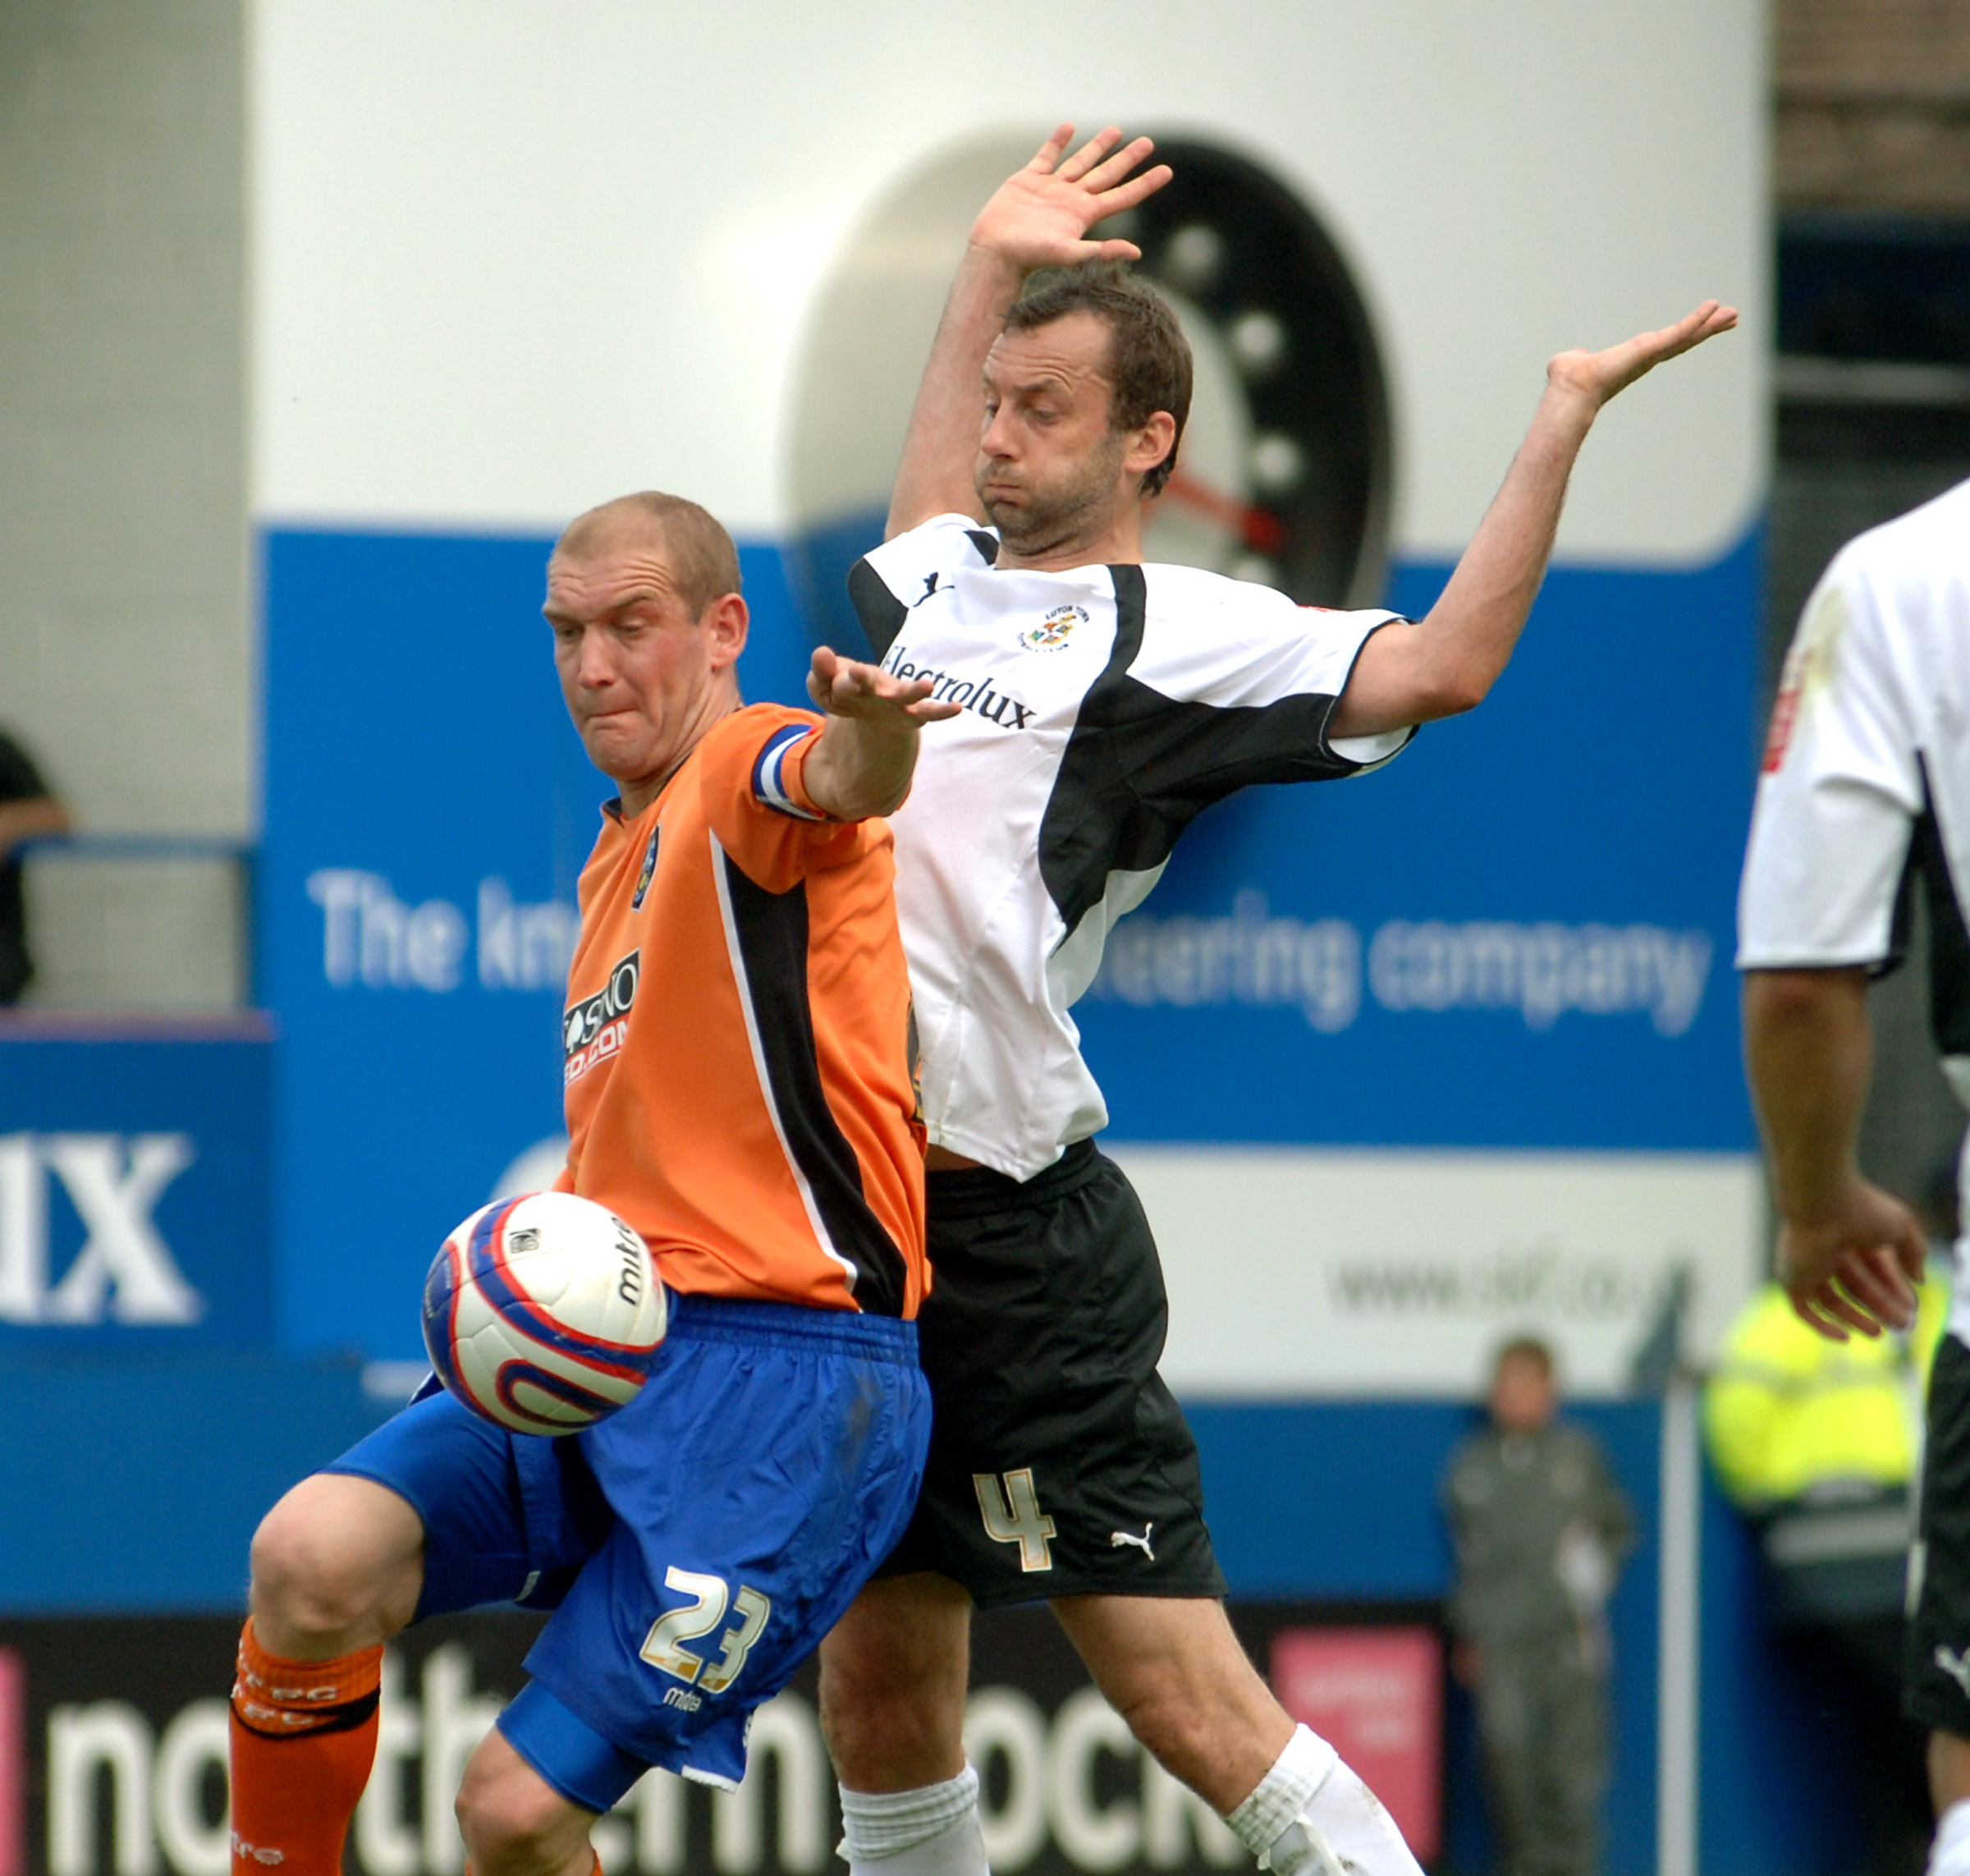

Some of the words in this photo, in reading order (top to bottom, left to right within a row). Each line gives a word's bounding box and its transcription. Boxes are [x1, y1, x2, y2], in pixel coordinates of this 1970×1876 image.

[306, 867, 468, 993] The
[1088, 887, 1359, 1036] eering
[1368, 917, 1716, 1038] company
[974, 1467, 1057, 1572] 4
[639, 1565, 772, 1695] 23
